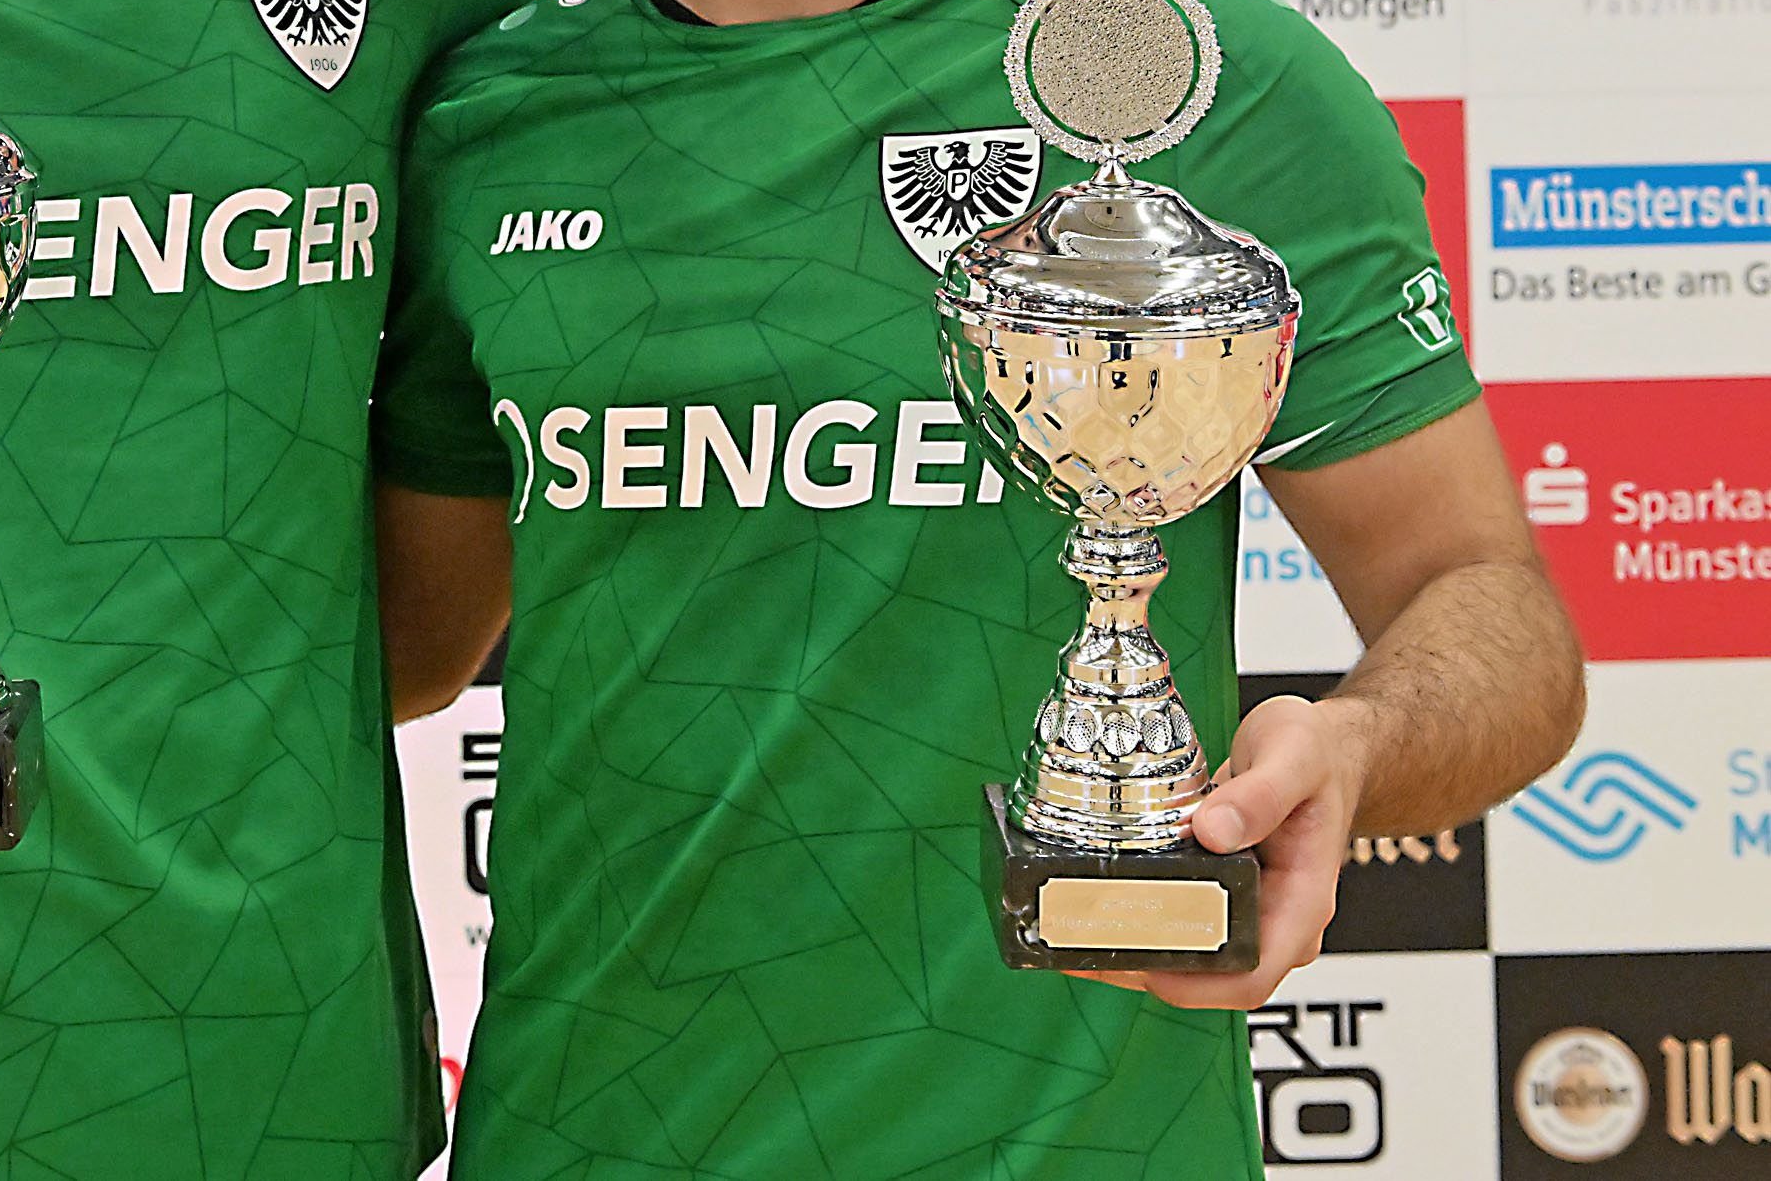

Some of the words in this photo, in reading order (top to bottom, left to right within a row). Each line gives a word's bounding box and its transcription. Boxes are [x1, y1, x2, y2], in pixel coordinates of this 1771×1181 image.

[309, 58, 338, 72] 1906
[490, 209, 604, 256] JAKO
[1492, 268, 1554, 301] Das
[1568, 266, 1663, 300] Beste
[1678, 269, 1732, 298] am
[539, 400, 1006, 510] SENGE
